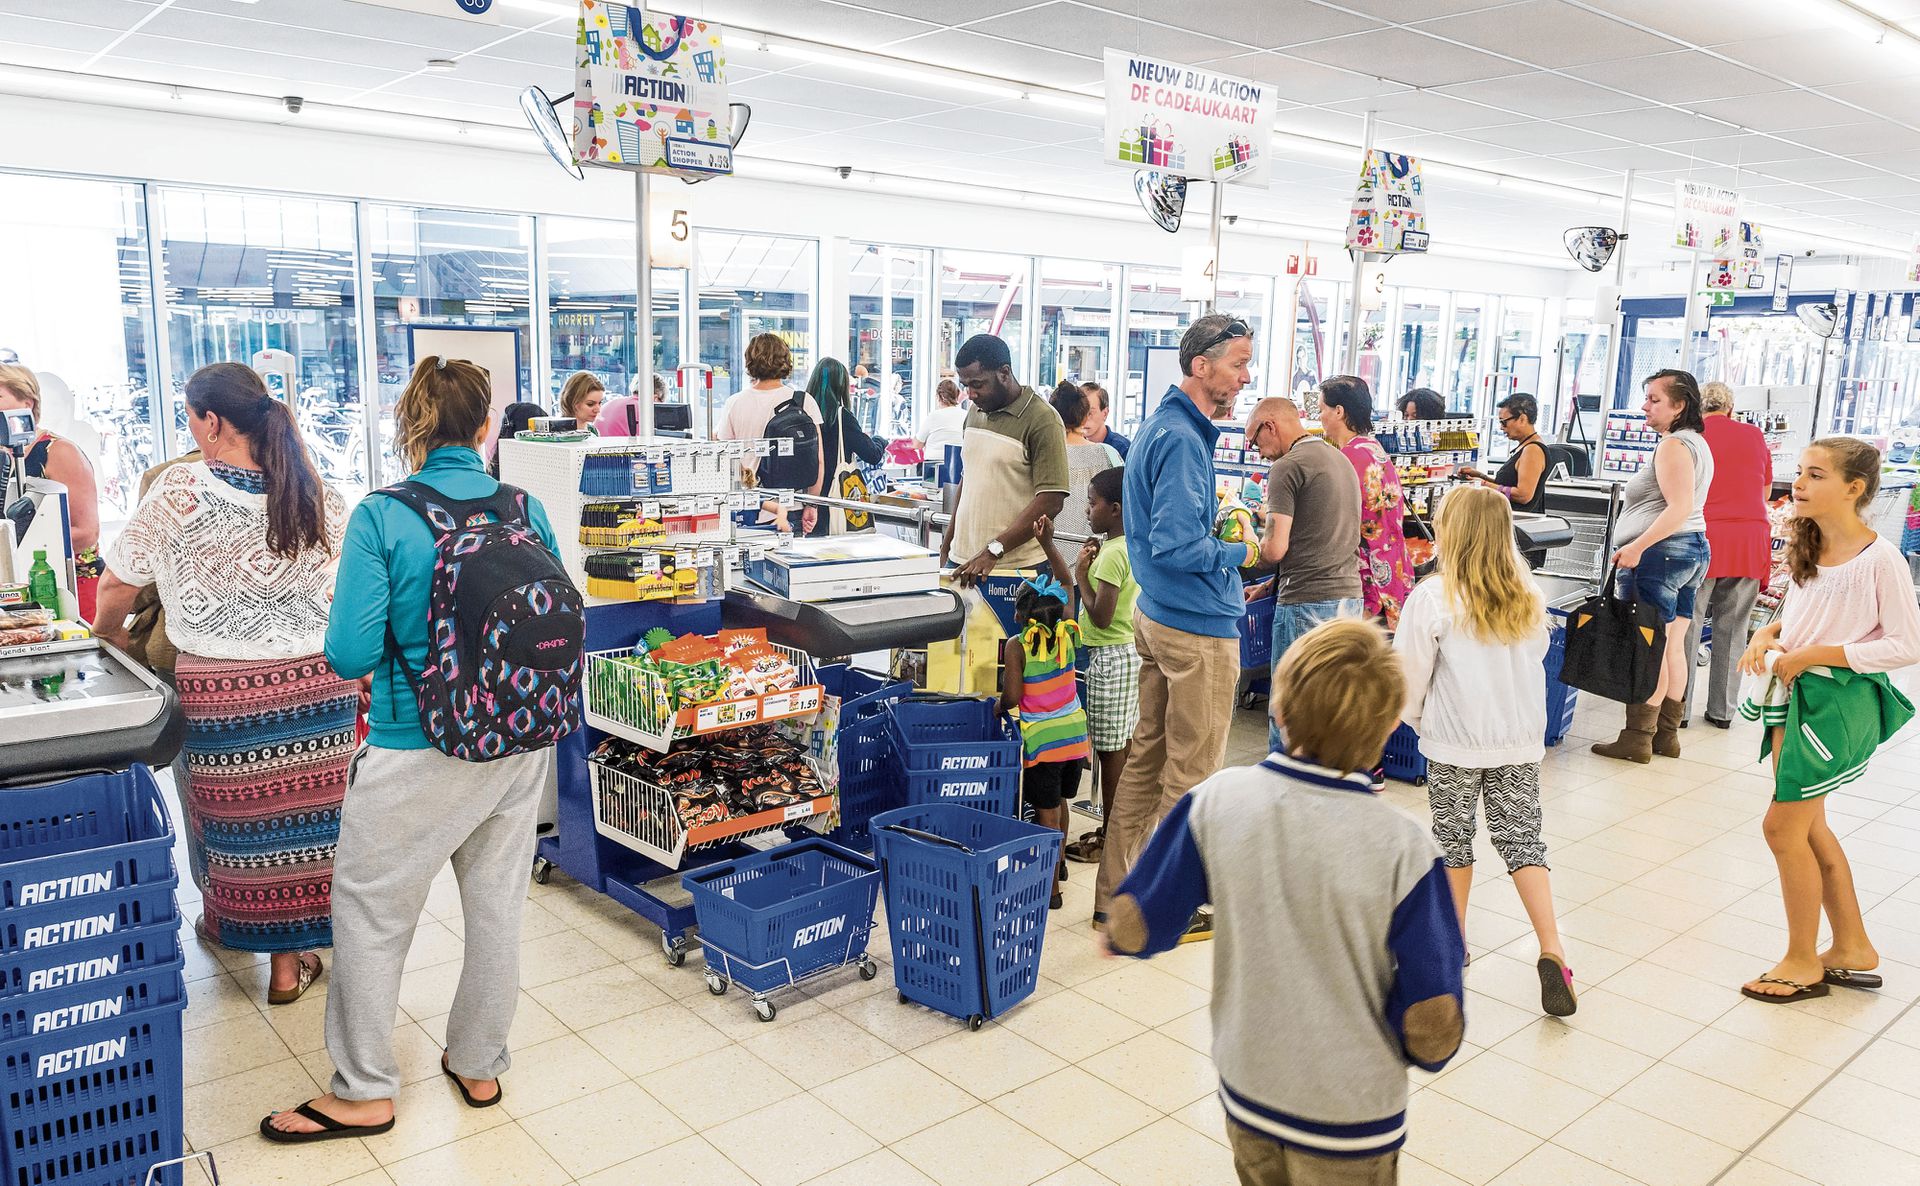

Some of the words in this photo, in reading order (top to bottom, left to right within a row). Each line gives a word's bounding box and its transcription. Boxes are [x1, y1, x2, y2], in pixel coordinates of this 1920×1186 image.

[624, 75, 685, 103] ACTION
[1128, 59, 1182, 86] NIEUW
[1185, 71, 1206, 92] BIJ
[1209, 77, 1261, 104] ACTION
[1130, 83, 1150, 102] DE
[1154, 88, 1257, 125] CADEAUKAART
[672, 149, 696, 158] ACTION
[672, 156, 703, 166] SHOPPER
[1387, 193, 1412, 208] ACTION
[671, 209, 689, 242] 5
[1203, 259, 1214, 281] 4
[1375, 272, 1385, 294] 3
[558, 313, 595, 326] HORREN
[988, 583, 1008, 596] Home
[30, 644, 50, 653] klant
[539, 638, 566, 650] DAKINE
[756, 659, 781, 673] Katja
[800, 699, 818, 710] 1.59
[738, 709, 757, 722] 1.99
[941, 755, 989, 770] ACTION
[940, 781, 988, 797] ACTION
[20, 869, 113, 906] ACTION
[24, 912, 116, 950] ACTION
[792, 914, 847, 950] ACTION
[28, 954, 119, 993] ACTION
[32, 995, 123, 1035] ACTION
[36, 1035, 127, 1079] ACTION
